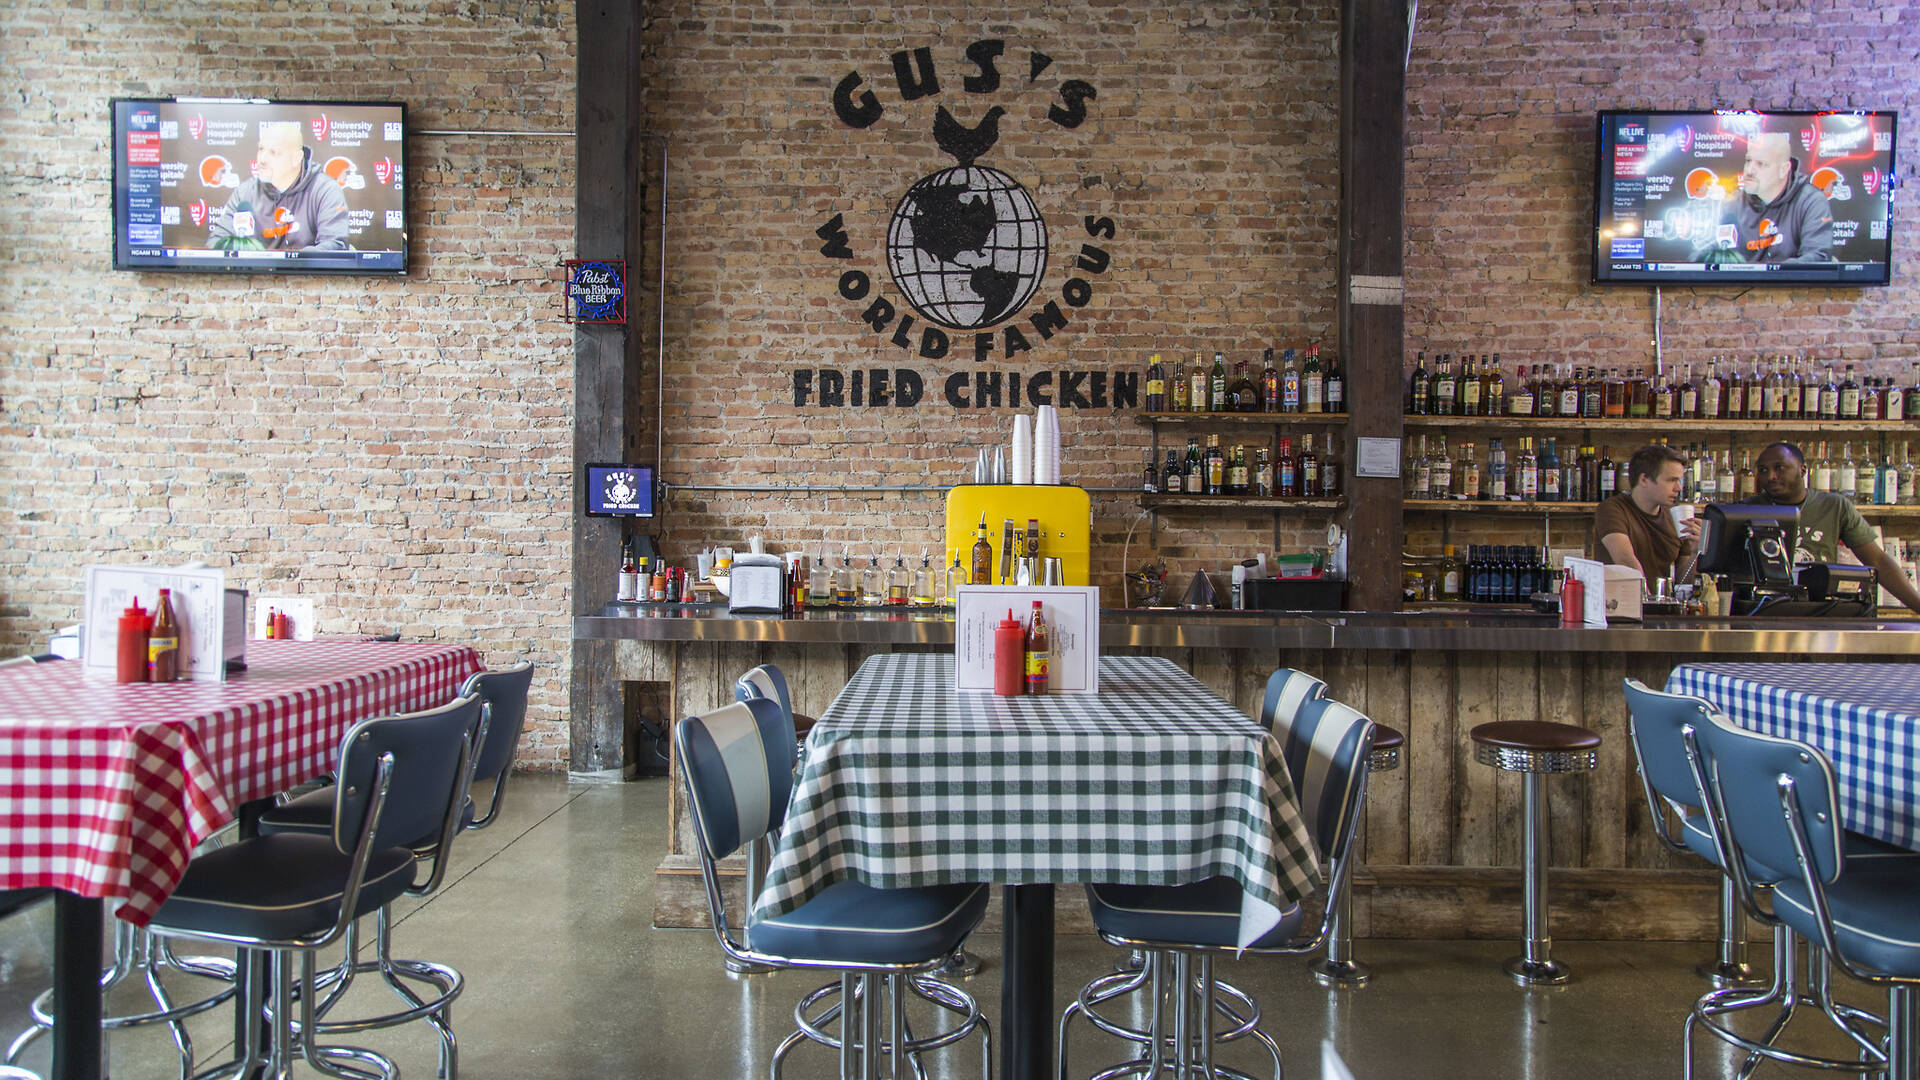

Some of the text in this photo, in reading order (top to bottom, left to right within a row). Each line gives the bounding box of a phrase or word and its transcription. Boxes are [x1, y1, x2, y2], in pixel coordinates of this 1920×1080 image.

[833, 40, 1097, 129] GUS'S
[207, 120, 247, 130] University
[330, 121, 372, 132] University
[207, 130, 244, 139] Hospitals
[330, 130, 368, 140] Hospitals
[1619, 128, 1645, 136] NFL LIVE
[1694, 133, 1734, 142] University
[1694, 142, 1732, 150] Hospitals
[580, 270, 610, 283] Pabst
[572, 284, 621, 294] Blue Ribbon
[816, 212, 950, 360] WORLD
[975, 215, 1116, 362] FAMOUS
[586, 295, 606, 303] BEER
[793, 368, 1138, 409] FRIED CHICKEN
